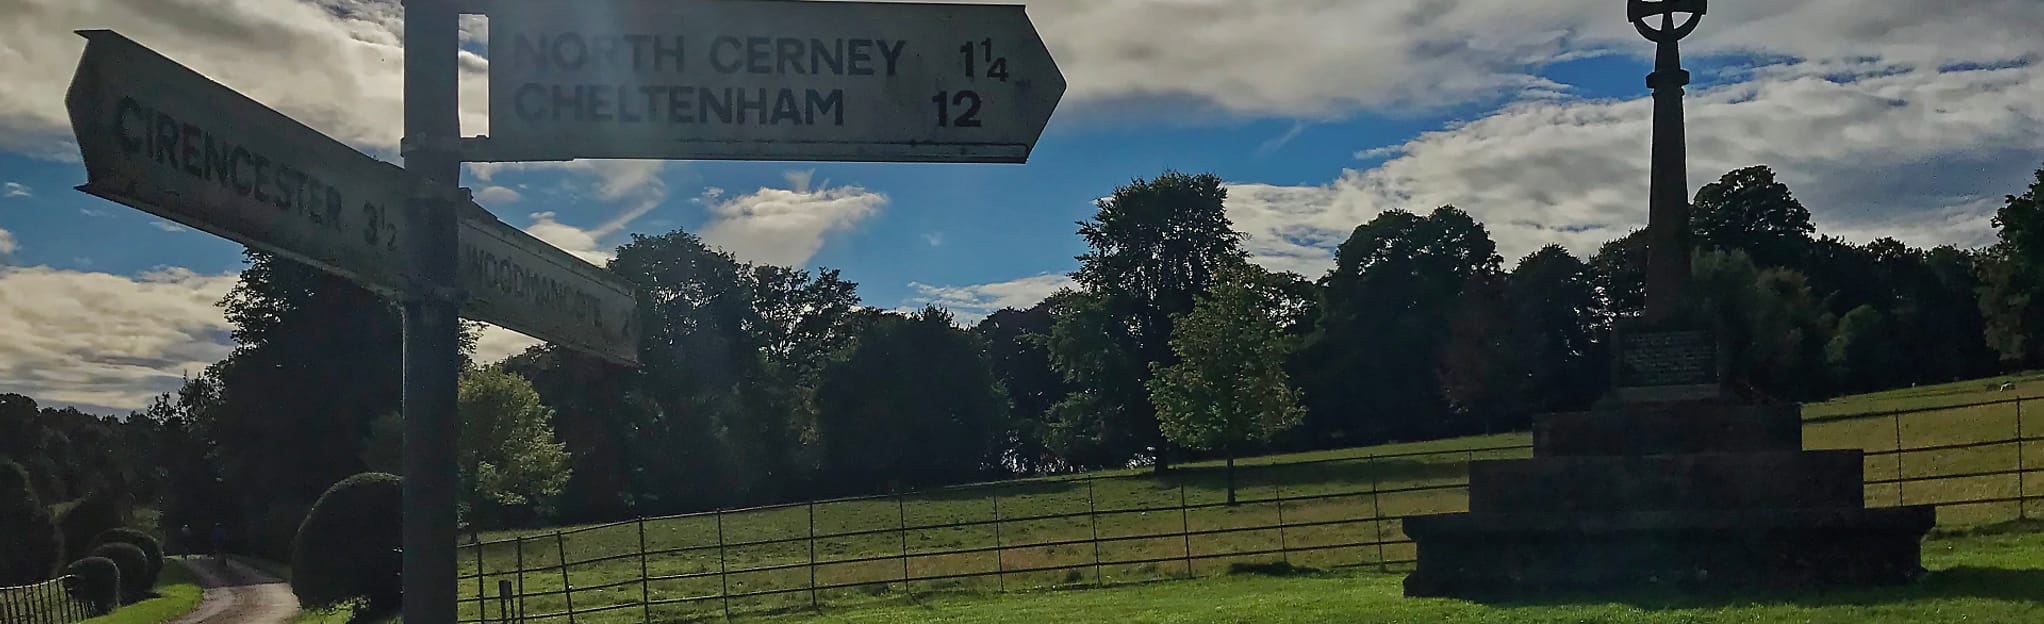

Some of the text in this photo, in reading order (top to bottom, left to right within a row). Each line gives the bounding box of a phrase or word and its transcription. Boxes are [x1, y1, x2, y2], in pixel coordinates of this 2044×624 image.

[514, 32, 686, 73] NORTH
[709, 35, 906, 77] CERNEY
[514, 83, 983, 128] CHELTENHAM 12
[117, 96, 342, 231] CIRENCESTER
